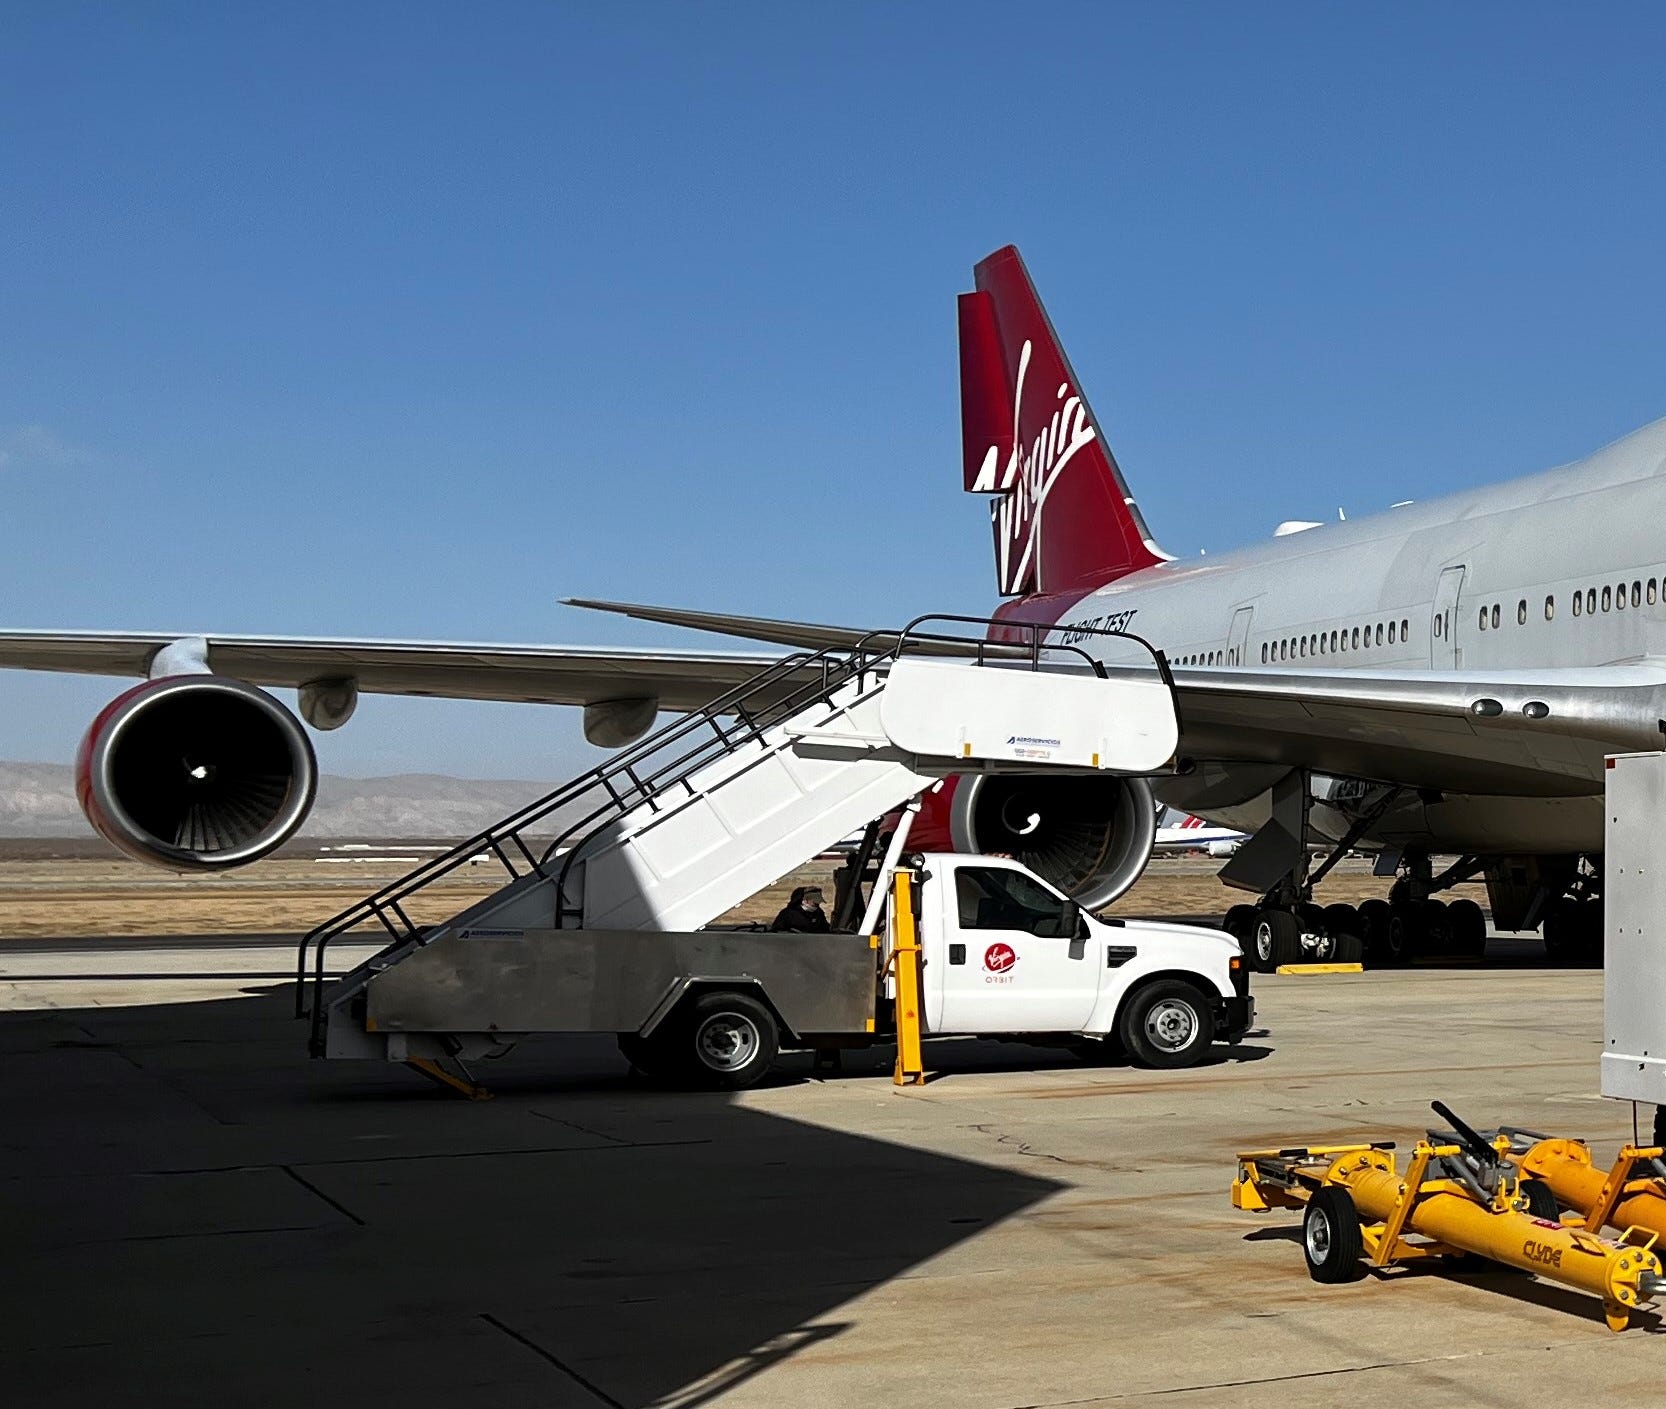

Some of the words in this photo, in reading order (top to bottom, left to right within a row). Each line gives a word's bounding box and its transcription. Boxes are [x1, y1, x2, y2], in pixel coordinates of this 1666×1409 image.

[1102, 609, 1138, 634] TEST
[985, 976, 1014, 984] ORBIT
[1523, 1240, 1563, 1268] CLYDE
